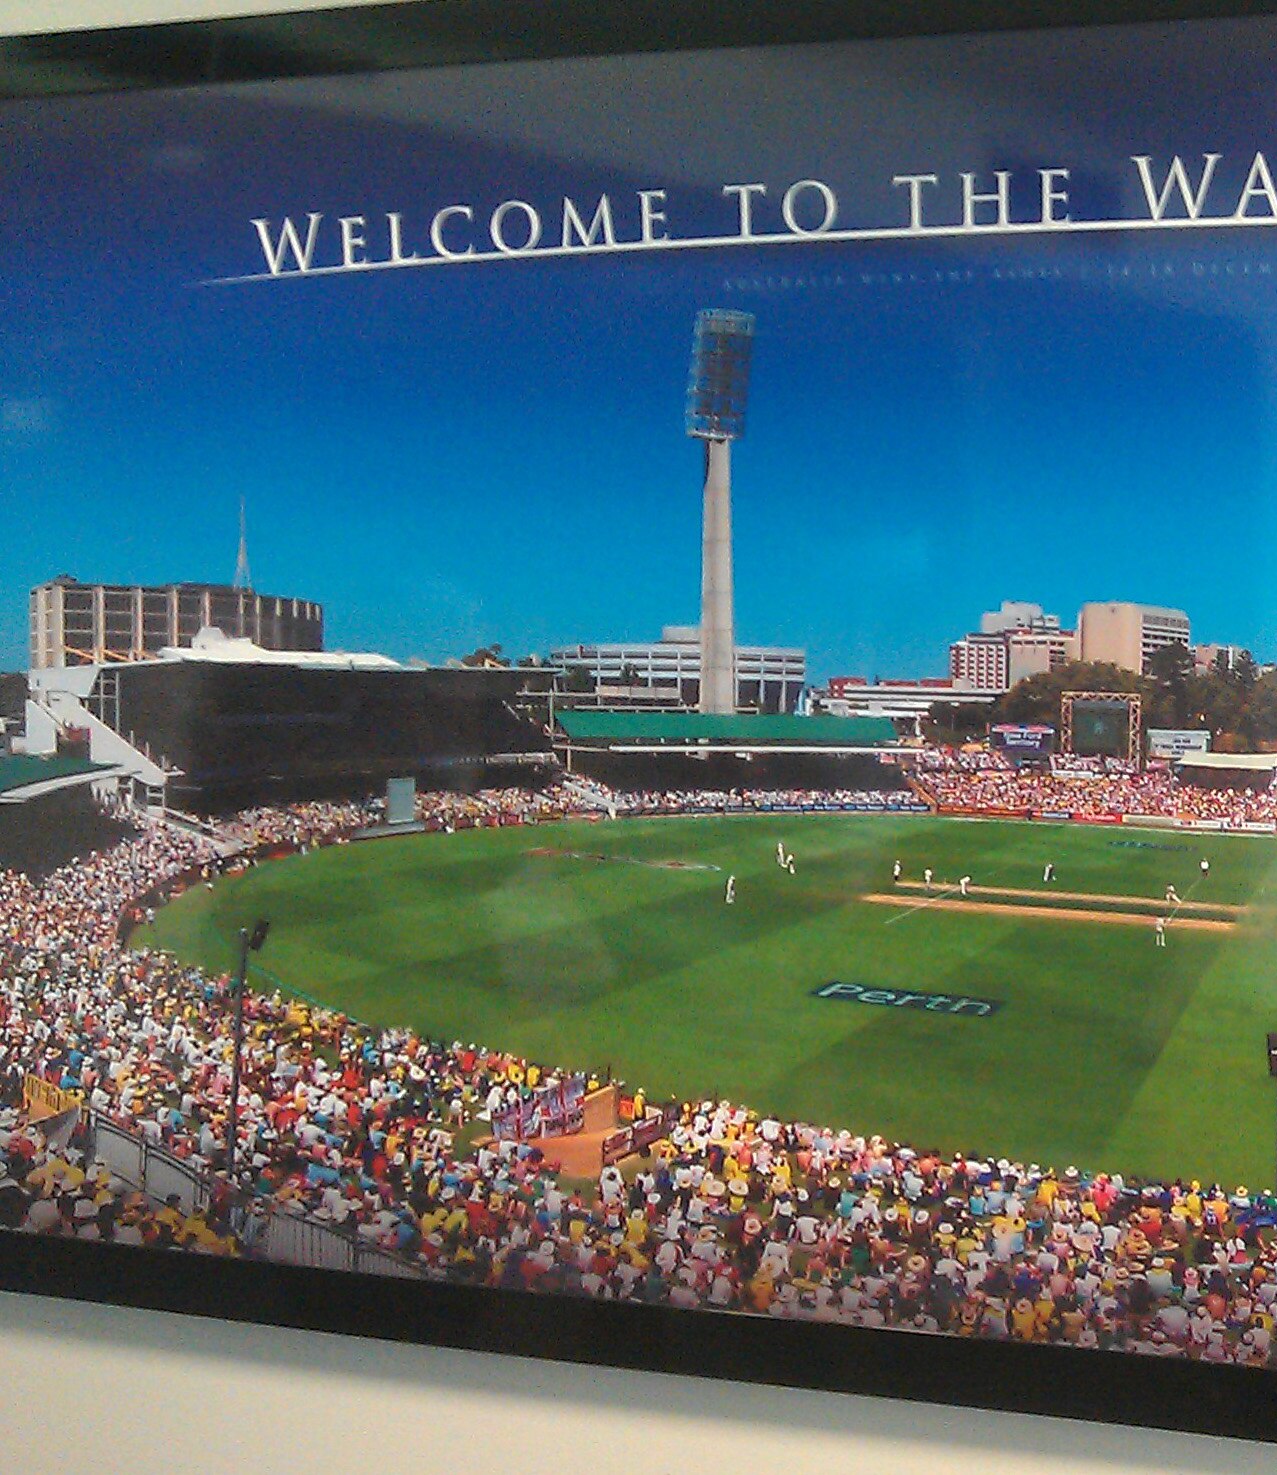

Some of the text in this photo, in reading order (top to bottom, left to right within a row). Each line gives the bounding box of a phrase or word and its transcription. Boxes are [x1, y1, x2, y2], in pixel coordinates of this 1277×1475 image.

[250, 190, 670, 275] WELCOME
[722, 178, 838, 239] TO
[892, 168, 1071, 232] THE
